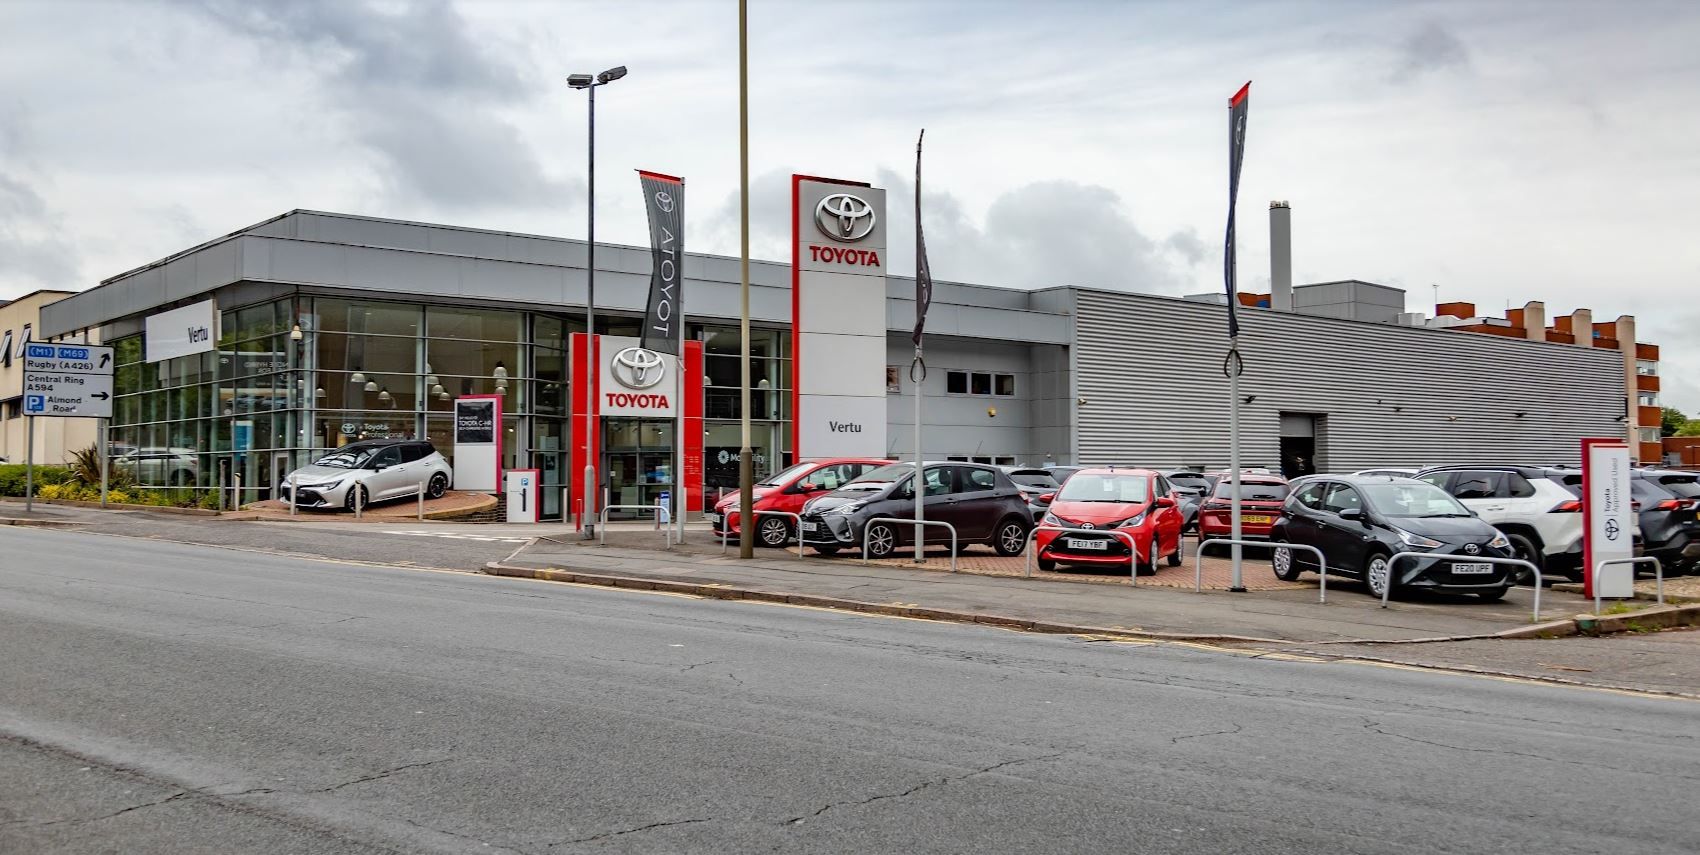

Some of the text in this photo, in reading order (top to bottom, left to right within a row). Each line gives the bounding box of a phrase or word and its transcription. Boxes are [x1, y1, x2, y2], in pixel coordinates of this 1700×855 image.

[809, 245, 880, 267] TOYOTA
[187, 326, 209, 344] Vertu
[29, 346, 88, 359] (M1) (M69)
[27, 360, 94, 371] Rugby (A426)
[27, 374, 85, 386] Central Ring
[27, 384, 54, 392] A594
[47, 395, 82, 404] Almond
[605, 393, 669, 409] TOYOTA
[363, 423, 390, 431] Toyota
[829, 420, 862, 433] Vertu
[1604, 488, 1612, 512] Toyota
[1612, 478, 1620, 512] Approved
[1072, 540, 1088, 548] FE17
[1455, 564, 1490, 572] FE20 UPF
